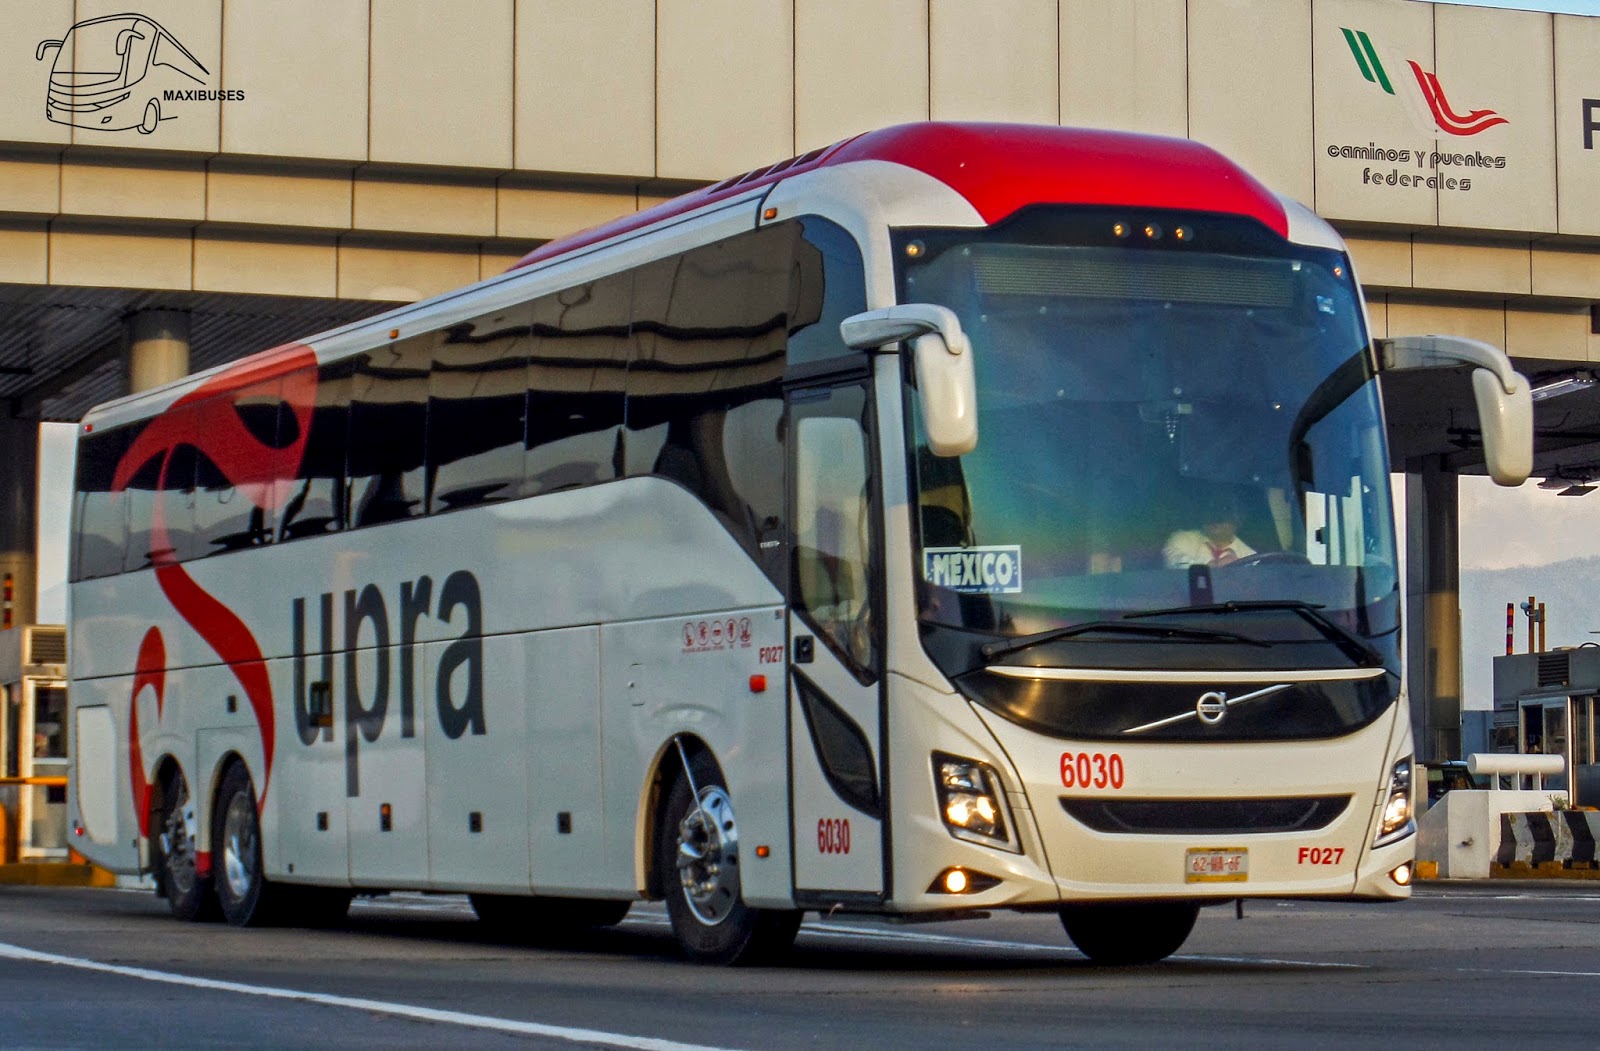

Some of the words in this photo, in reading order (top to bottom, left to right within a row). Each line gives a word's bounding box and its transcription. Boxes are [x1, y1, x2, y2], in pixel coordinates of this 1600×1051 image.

[1327, 142, 1410, 162] caminos
[1429, 150, 1506, 169] puentes
[1363, 168, 1472, 191] federales
[759, 645, 784, 663] F027
[1059, 752, 1125, 789] 6030
[817, 818, 851, 855] 6030
[1297, 847, 1345, 865] F027
